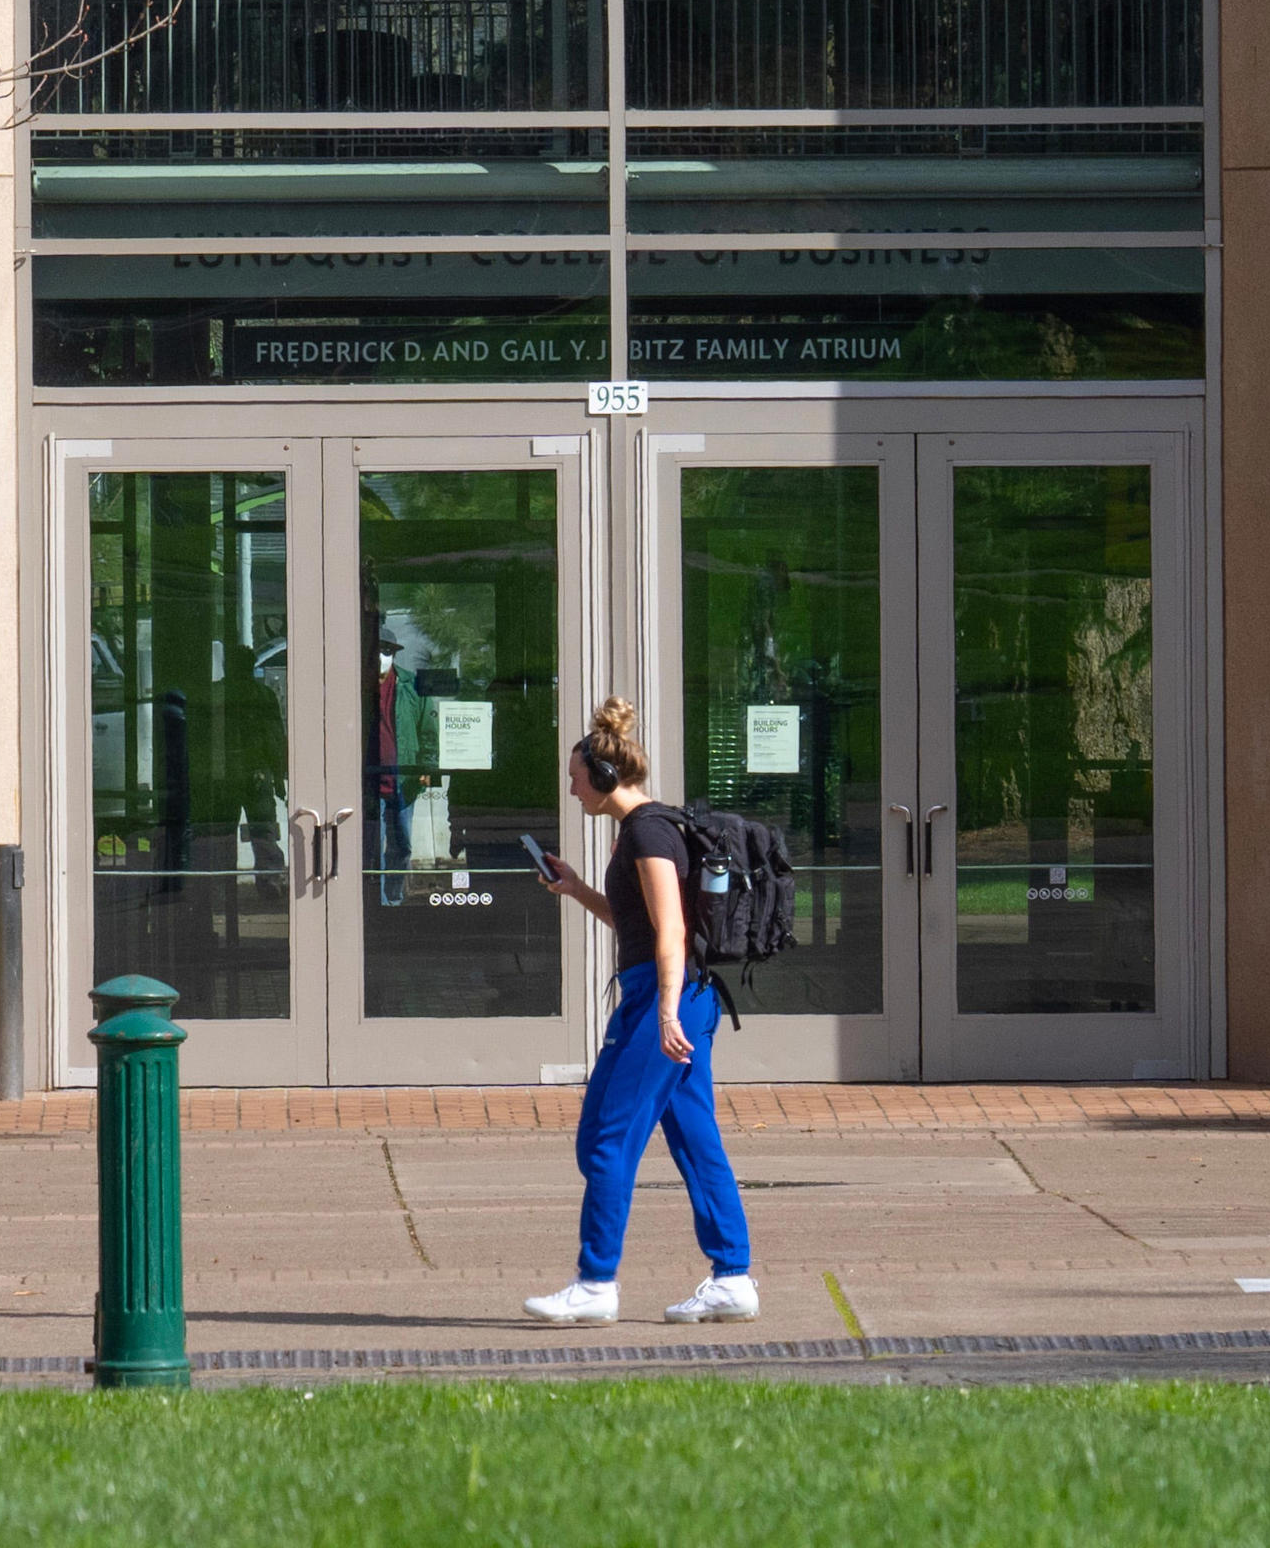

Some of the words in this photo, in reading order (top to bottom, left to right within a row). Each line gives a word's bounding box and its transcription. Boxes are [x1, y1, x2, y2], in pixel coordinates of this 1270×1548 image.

[470, 230, 666, 266] COLLEE
[256, 341, 395, 363] FREDERICK
[404, 341, 426, 362] D.
[433, 340, 489, 362] AND
[500, 339, 561, 361] GAIL
[570, 339, 590, 361] Y.
[596, 339, 684, 361] JBITZ
[696, 338, 789, 360] FAMILY
[800, 338, 902, 360] ATRIUM
[597, 386, 640, 411] 955
